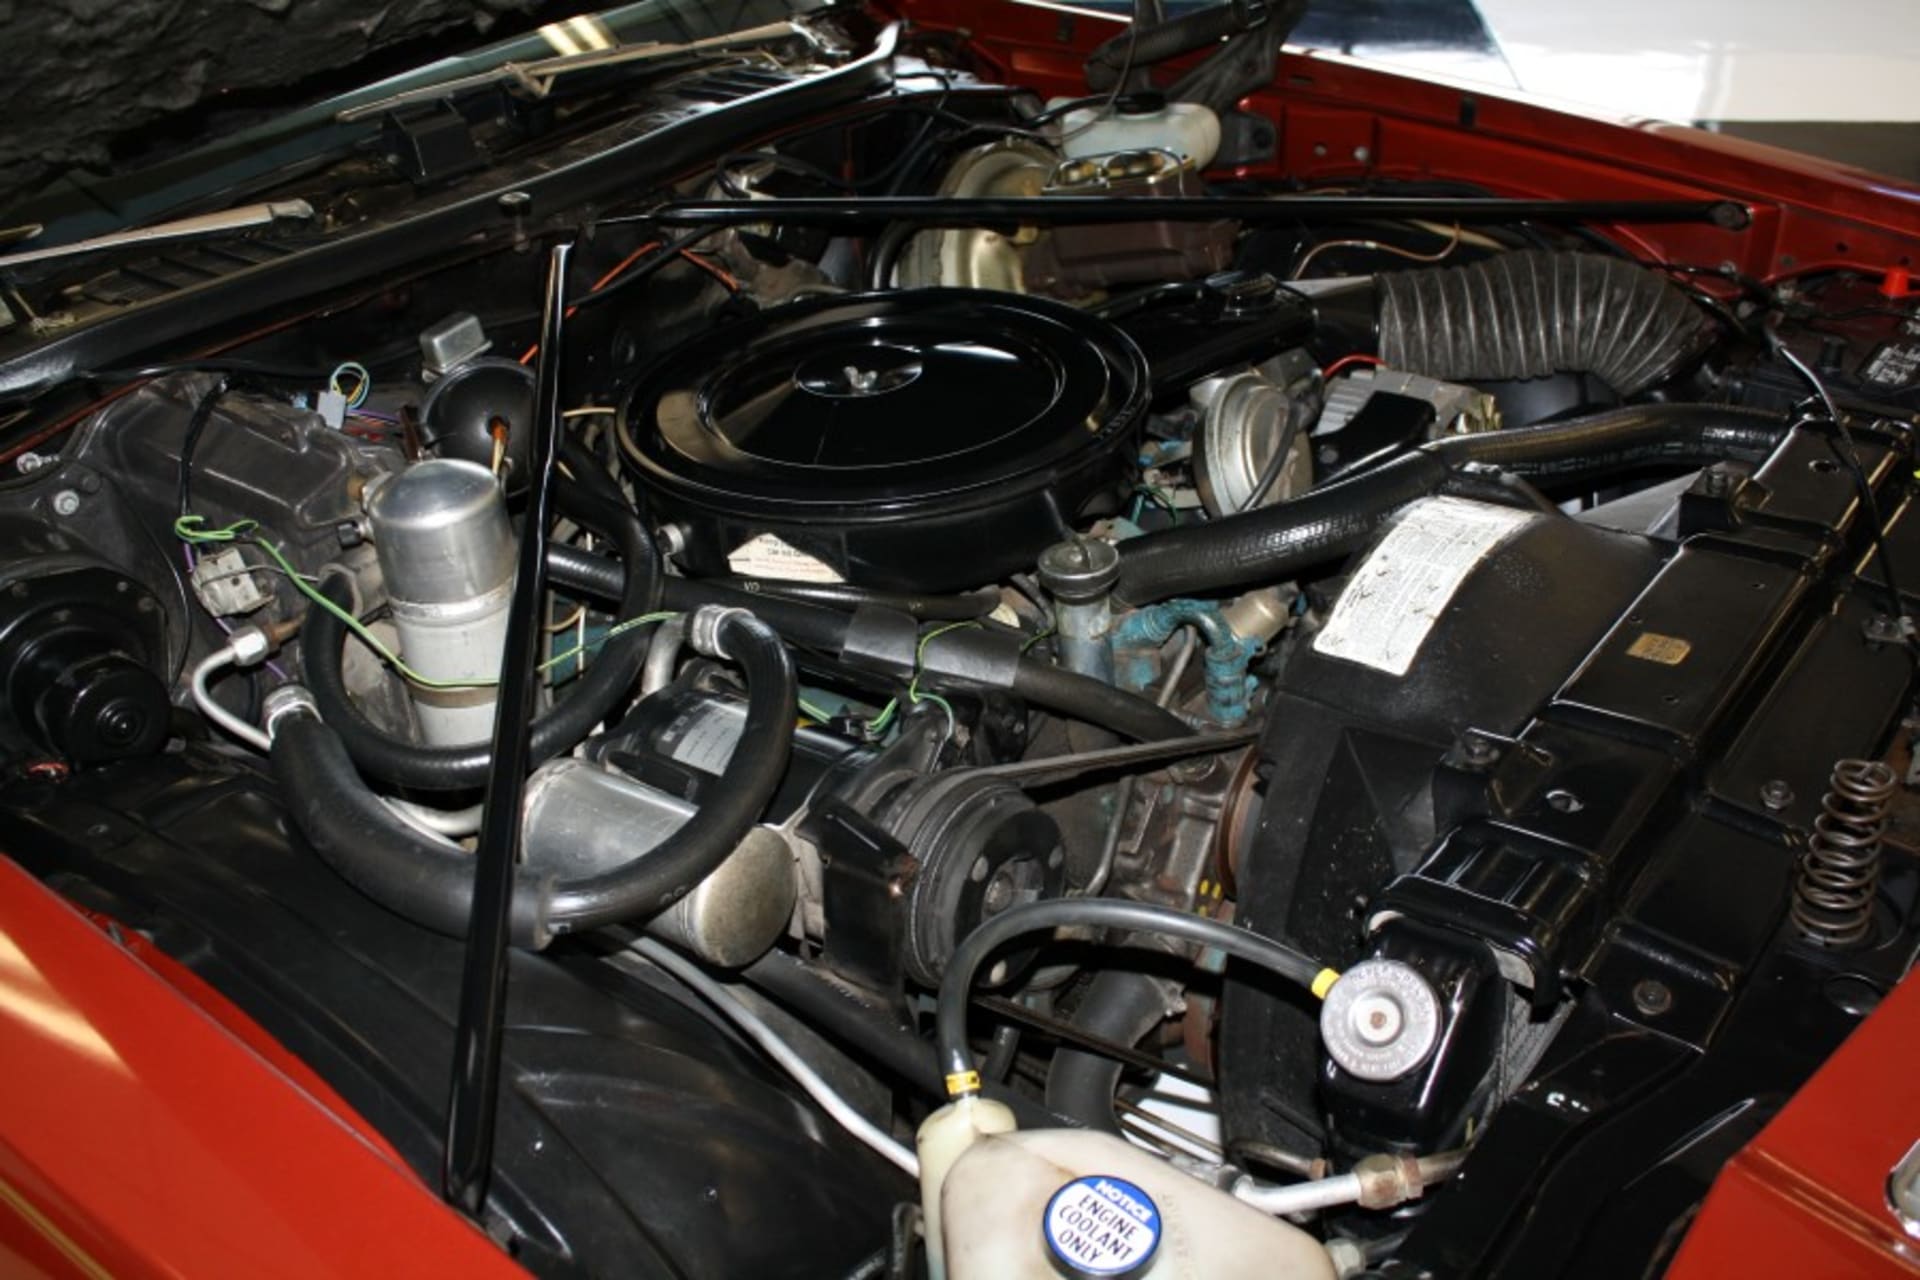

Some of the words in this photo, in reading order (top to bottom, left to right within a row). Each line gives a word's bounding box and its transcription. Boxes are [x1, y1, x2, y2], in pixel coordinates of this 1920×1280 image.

[1079, 1194, 1138, 1240] ENGINE
[1095, 1180, 1152, 1222] NOTICE
[1059, 1205, 1134, 1260] COOLANT
[1059, 1229, 1102, 1262] ONLY
